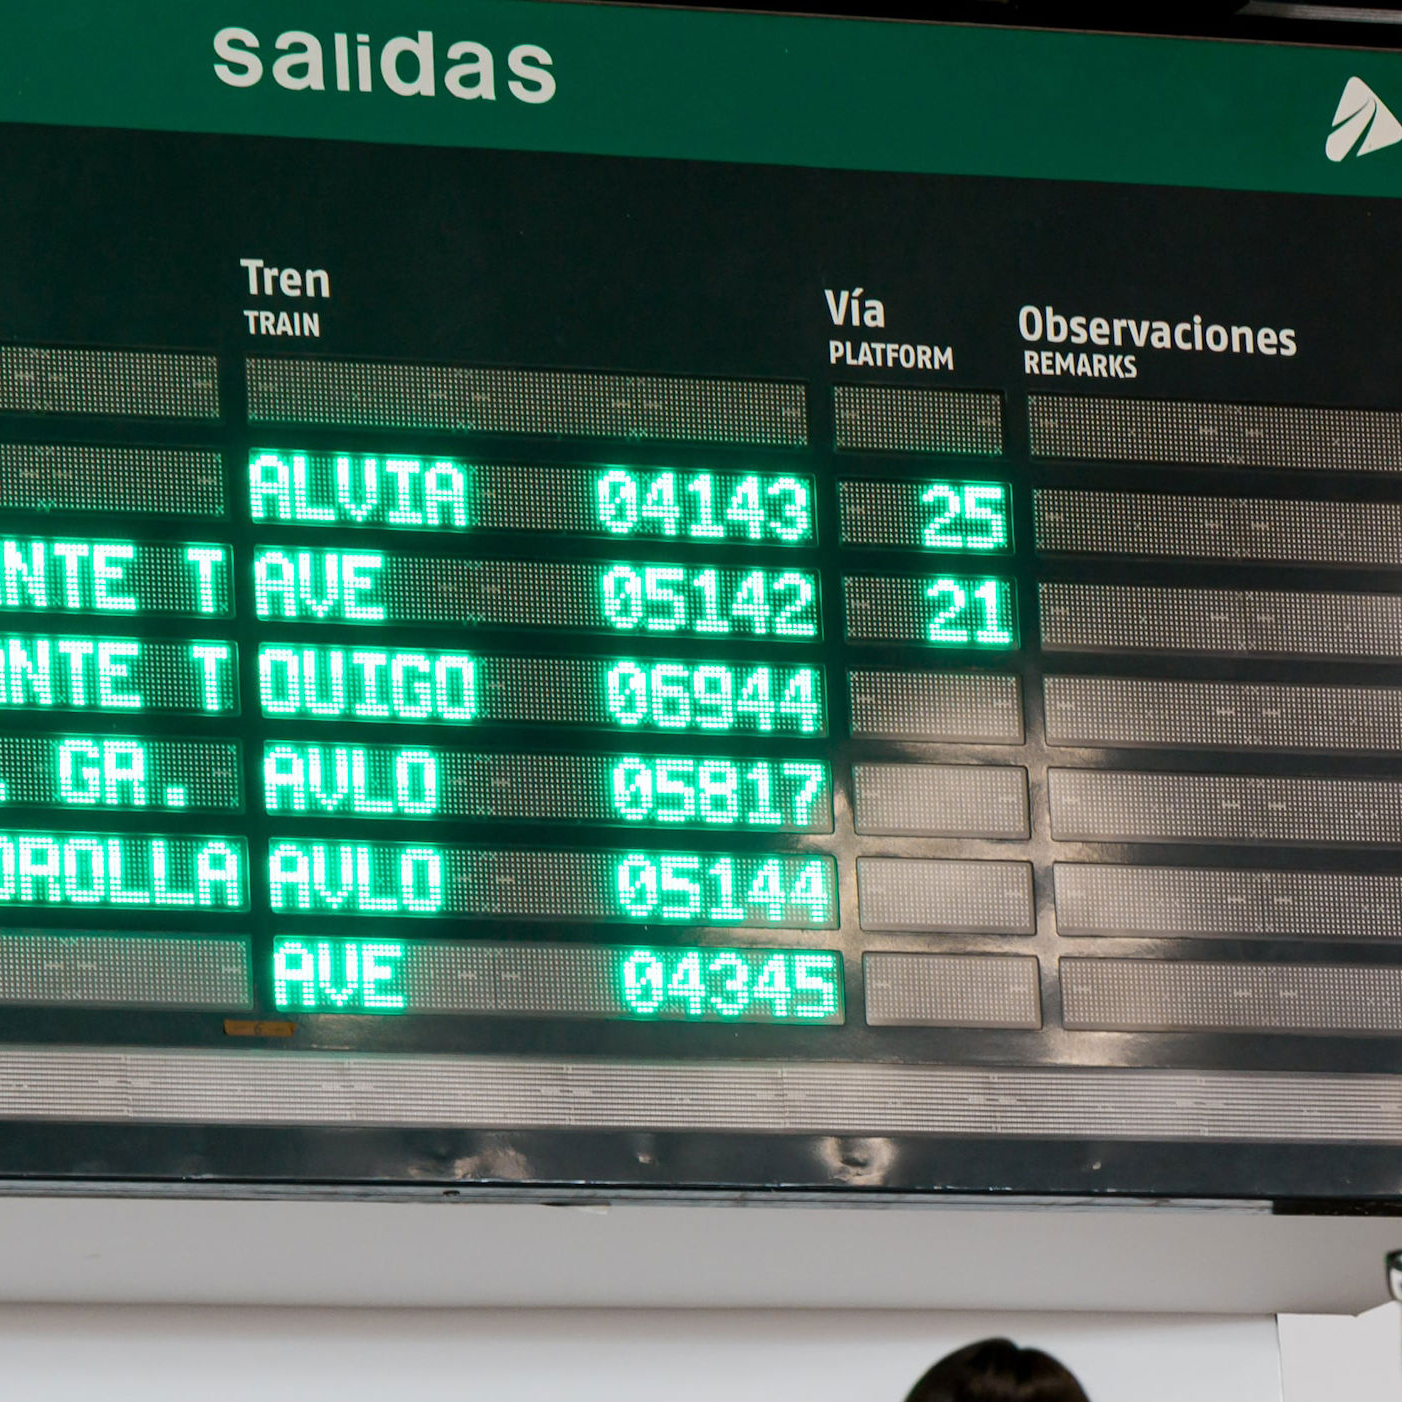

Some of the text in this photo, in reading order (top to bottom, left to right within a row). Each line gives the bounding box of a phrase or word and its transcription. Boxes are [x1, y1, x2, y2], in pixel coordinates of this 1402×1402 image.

[213, 27, 556, 104] salidas
[240, 258, 330, 298] Tren
[824, 286, 884, 328] Vía
[243, 310, 320, 337] TRAIN
[829, 340, 954, 370] PLATFORM
[1019, 304, 1297, 356] Observaciones
[1023, 350, 1138, 379] REMARKS
[249, 454, 467, 526] ALVIA
[597, 470, 808, 541] 04143
[922, 484, 1004, 549] 25
[187, 547, 223, 613] T
[254, 551, 385, 620] AVE
[602, 564, 815, 637] 05142
[926, 578, 1010, 644] 21
[192, 645, 228, 711] T
[258, 648, 477, 720] OUIGO
[607, 661, 821, 732] 06944
[58, 739, 186, 807] GR.
[263, 746, 437, 815] AVLO
[612, 757, 825, 827] 05817
[268, 843, 442, 913] AVLO
[617, 853, 829, 924] 05144
[273, 941, 405, 1011] AVE
[622, 950, 835, 1018] 04345
